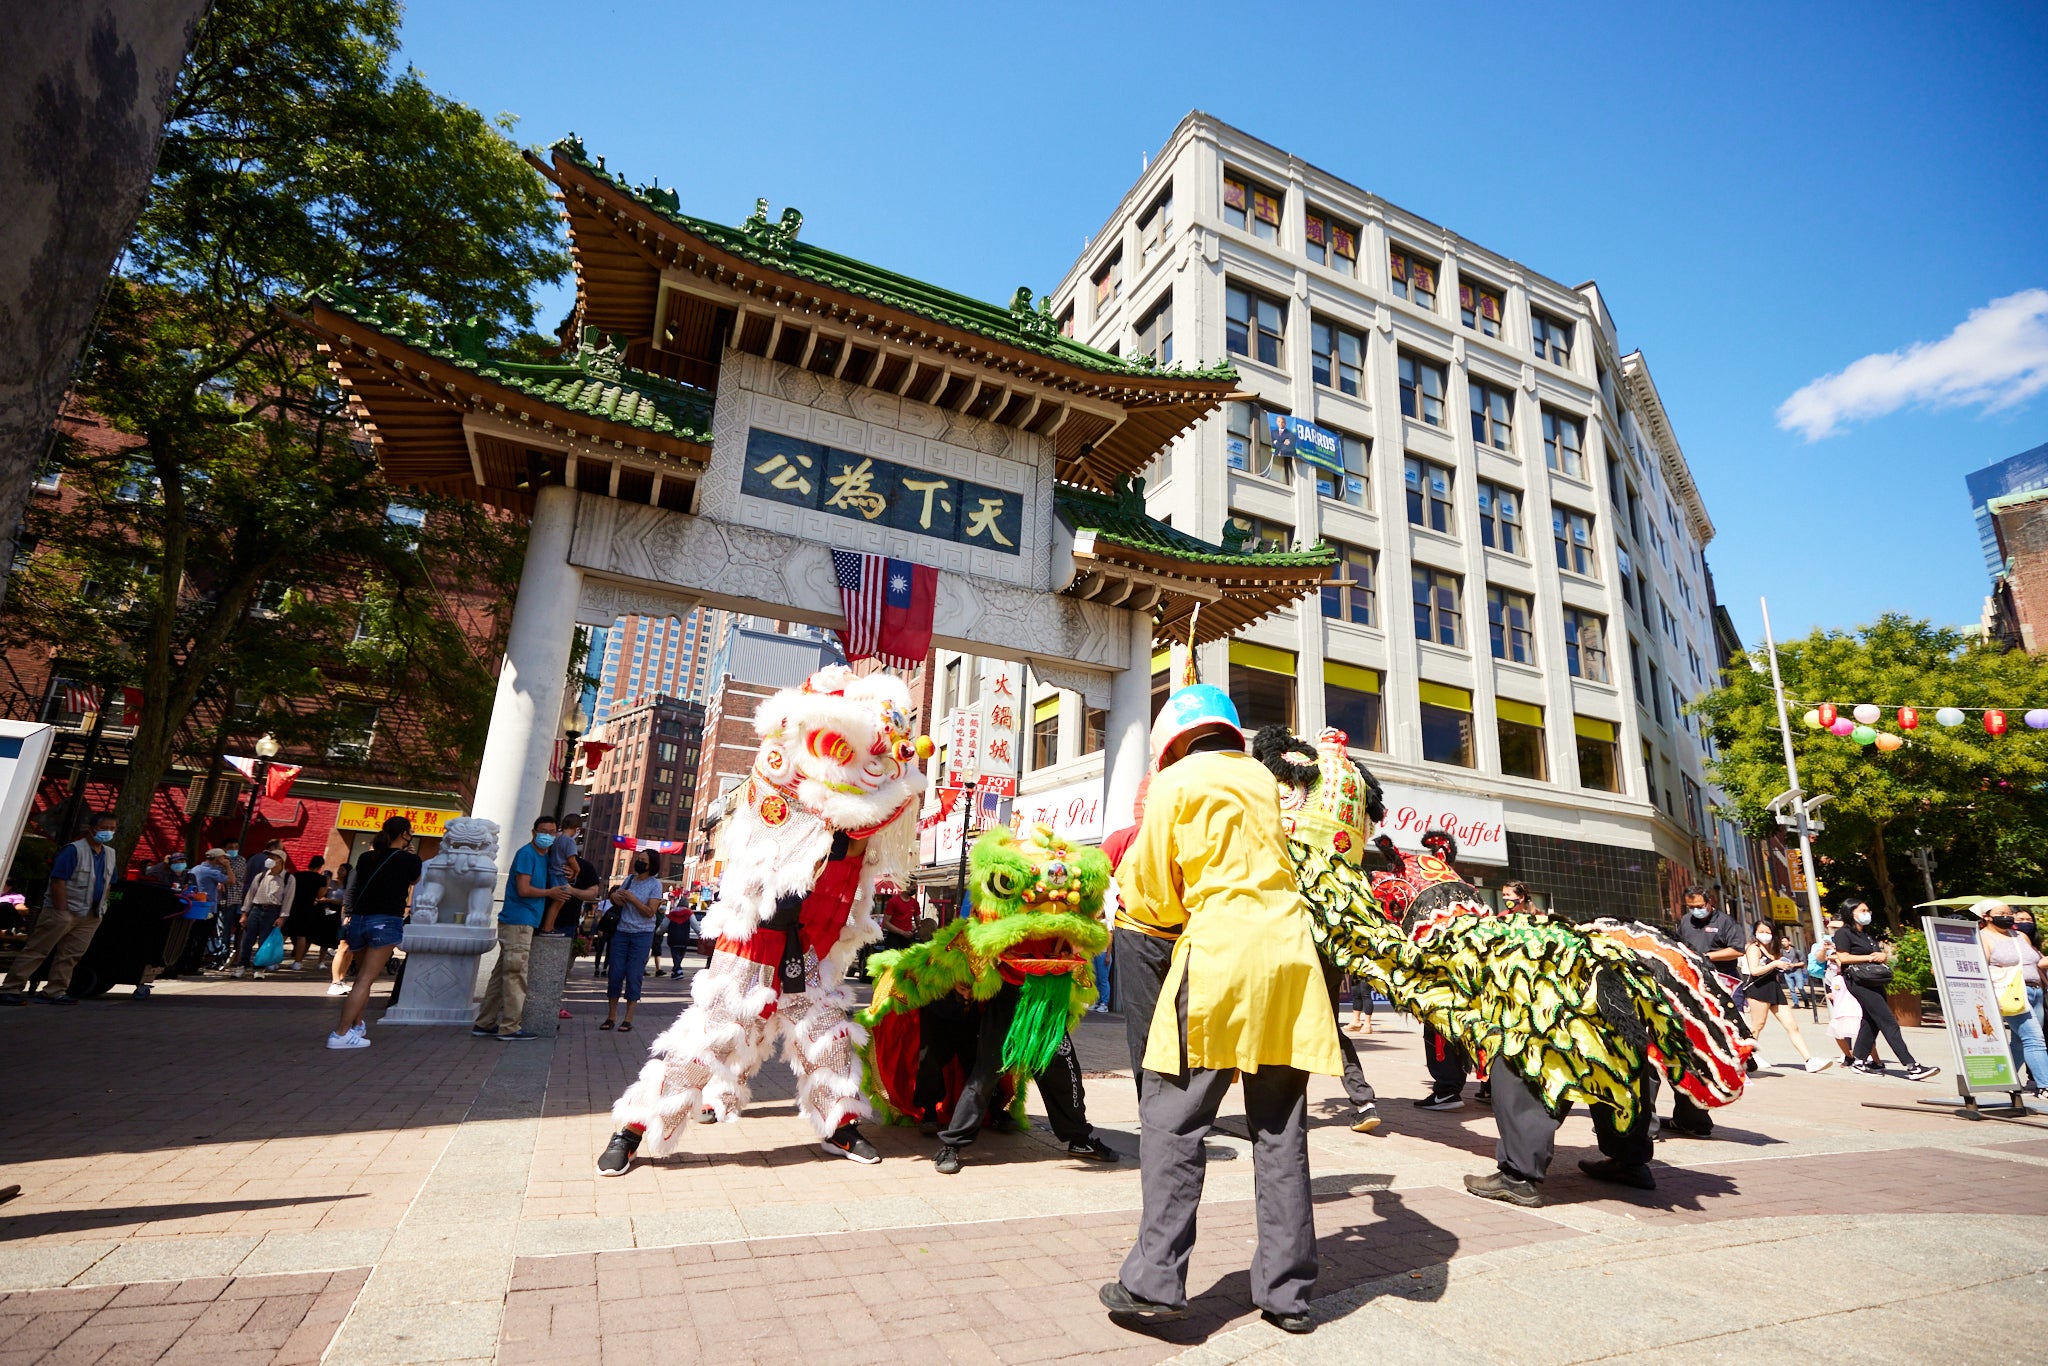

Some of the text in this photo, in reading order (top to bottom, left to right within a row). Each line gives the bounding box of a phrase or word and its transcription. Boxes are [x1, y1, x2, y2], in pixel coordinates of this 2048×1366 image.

[1297, 424, 1336, 452] BARROS
[988, 660, 1013, 764] 火鍋城
[987, 777, 1011, 787] POT
[342, 819, 370, 828] HING
[413, 825, 445, 834] PASTR
[1065, 797, 1097, 828] Pot
[1395, 807, 1432, 832] Pot
[1440, 813, 1501, 847] Buffet
